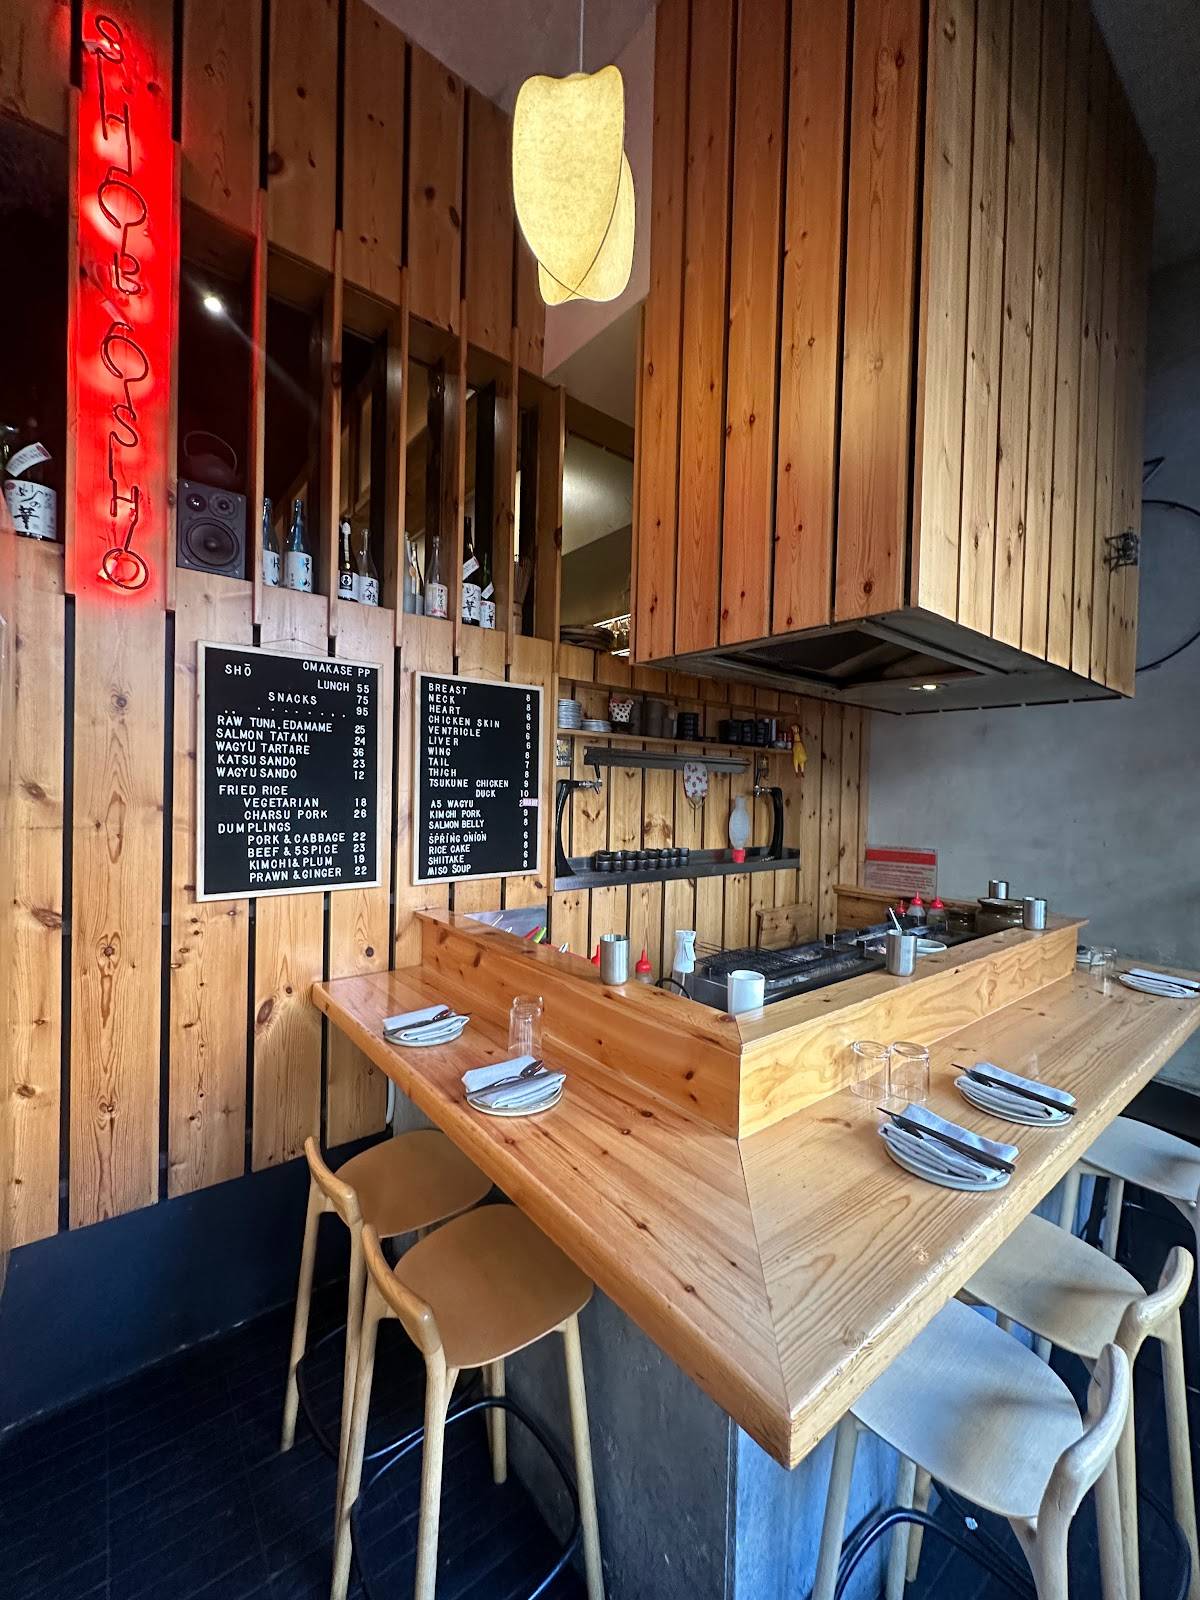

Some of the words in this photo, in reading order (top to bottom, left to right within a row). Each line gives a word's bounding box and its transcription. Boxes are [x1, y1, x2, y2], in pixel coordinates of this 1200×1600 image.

[302, 661, 353, 676] OMAKASE
[357, 668, 371, 677] PP
[317, 680, 350, 692] LUNCH
[356, 683, 370, 694] 55
[428, 682, 467, 695] BREAST
[268, 691, 318, 705] SNACKS
[356, 695, 369, 705] 75
[428, 693, 455, 705] NECK
[356, 706, 369, 717] 95
[429, 704, 461, 715] HEART
[217, 715, 243, 727] RAW
[354, 725, 365, 735] 25
[428, 714, 471, 726] CHICKEN
[476, 718, 500, 729] SKIN
[216, 728, 264, 741] SALMON
[270, 730, 308, 743] TATAKI
[354, 736, 366, 746] 24
[428, 725, 481, 738] VENTRICLE
[428, 736, 459, 746] LIVER
[215, 740, 256, 753] WAGYU
[261, 743, 310, 755] TARTARE
[352, 748, 365, 757] 36
[427, 746, 451, 756] WING
[217, 754, 256, 765] KATSU
[259, 755, 297, 767] SANDO
[352, 759, 365, 769] 23
[428, 757, 450, 767] TAIL
[524, 761, 530, 769] 7
[216, 767, 257, 778] WAGYU
[259, 768, 298, 779] SANDO
[353, 770, 365, 780] 12
[428, 768, 457, 777] THIGH
[429, 778, 469, 788] TSUKUNE
[475, 779, 509, 788] CHICKEN
[219, 784, 256, 796] FRIED
[262, 785, 288, 796] RICE
[475, 789, 496, 798] DUCK
[520, 789, 529, 798] 10
[243, 798, 319, 808] VEGETARIAN
[355, 797, 367, 807] 18
[430, 799, 442, 809] A5
[446, 799, 474, 809] WAGYU
[244, 810, 291, 821] CHARSU
[297, 809, 328, 820] PORK
[353, 809, 367, 819] 26
[429, 809, 457, 819] KIMCHI
[461, 809, 481, 819] PORK
[217, 822, 291, 835] DUMPLINGS
[428, 820, 460, 830] SALMON
[461, 819, 485, 829] BELLY
[247, 834, 280, 846] PORK
[283, 834, 292, 844] &
[294, 832, 346, 844] CABBAGE
[352, 831, 366, 842] 22
[463, 832, 487, 843] ONION
[248, 846, 279, 858] BEEF
[283, 846, 292, 856] &
[352, 843, 365, 853] 23
[428, 845, 447, 855] RICE
[450, 844, 471, 853] CAKE
[302, 856, 333, 867] PLUM
[427, 854, 465, 866] SHIITAKE
[250, 871, 289, 883] PRAWN
[301, 867, 342, 880] GINGER
[354, 865, 367, 875] 22
[427, 866, 448, 876] MISO
[452, 864, 472, 874] SOUP
